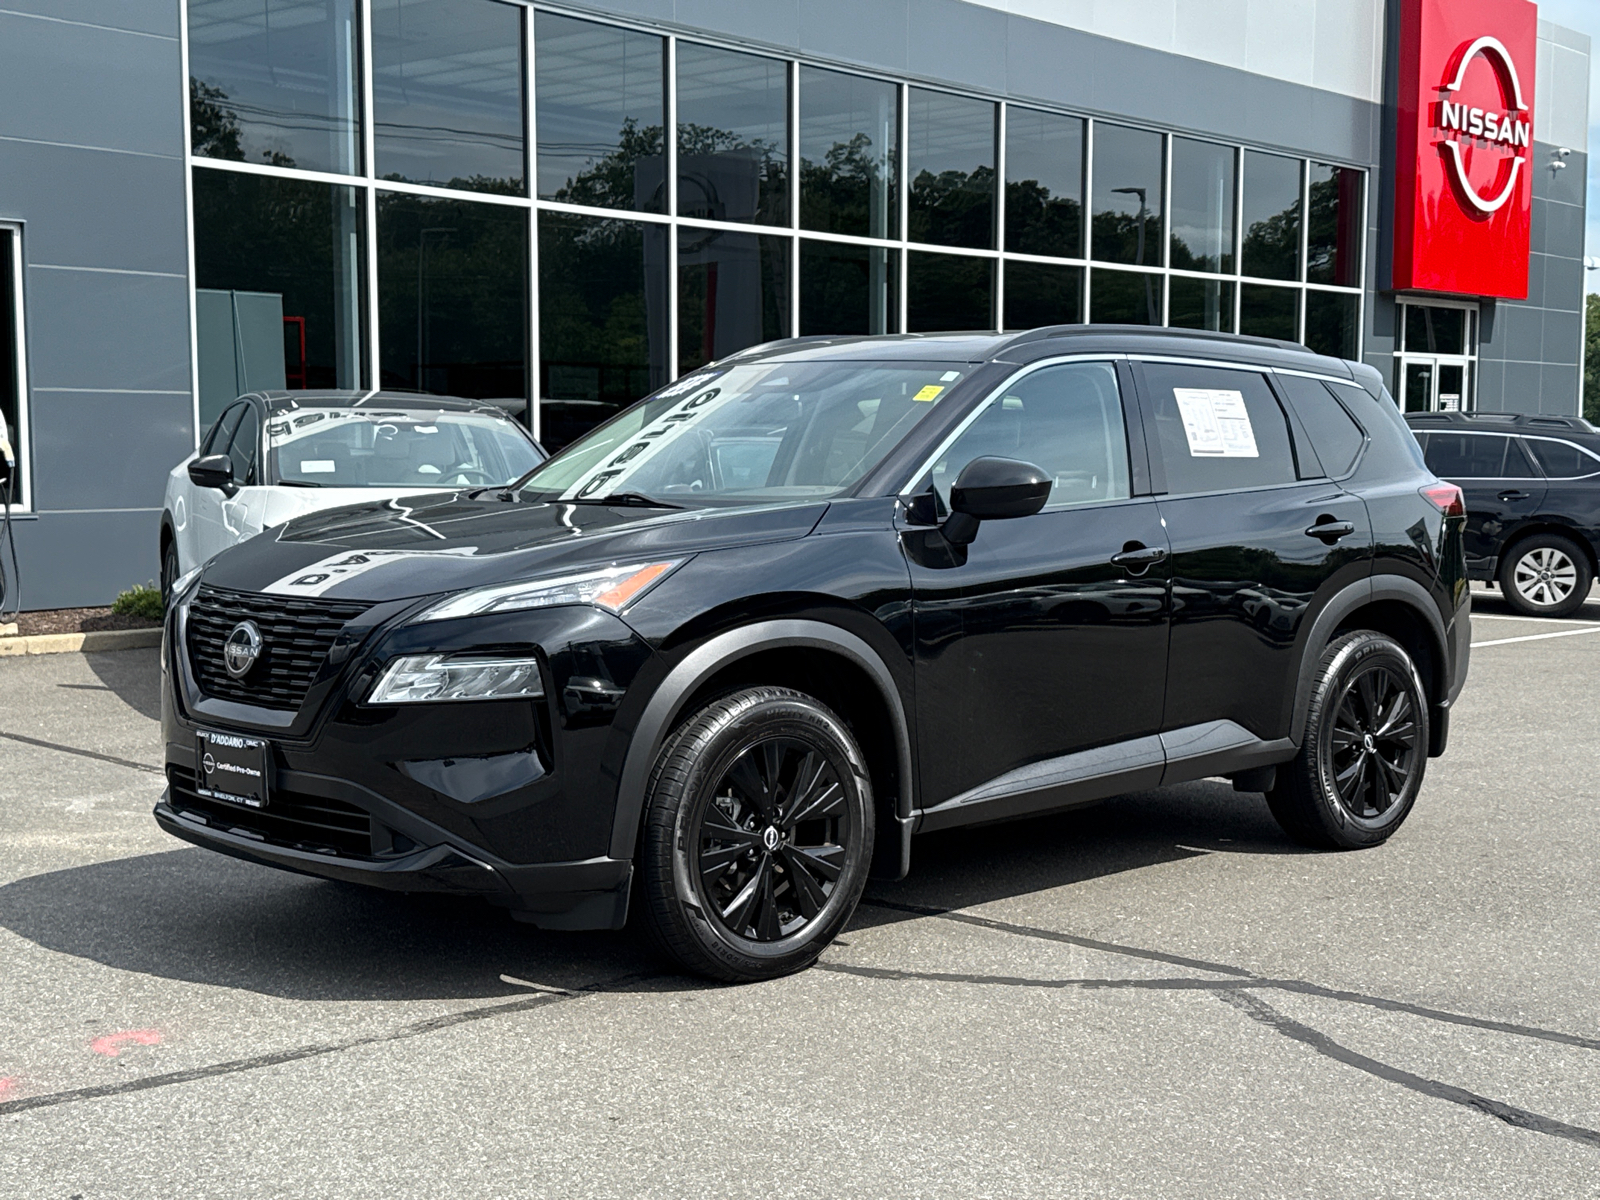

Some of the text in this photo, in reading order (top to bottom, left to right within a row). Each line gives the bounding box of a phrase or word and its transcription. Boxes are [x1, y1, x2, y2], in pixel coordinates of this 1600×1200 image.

[1442, 100, 1530, 148] NISSAN
[211, 734, 243, 748] D'ADDARIO
[217, 762, 236, 772] Certified
